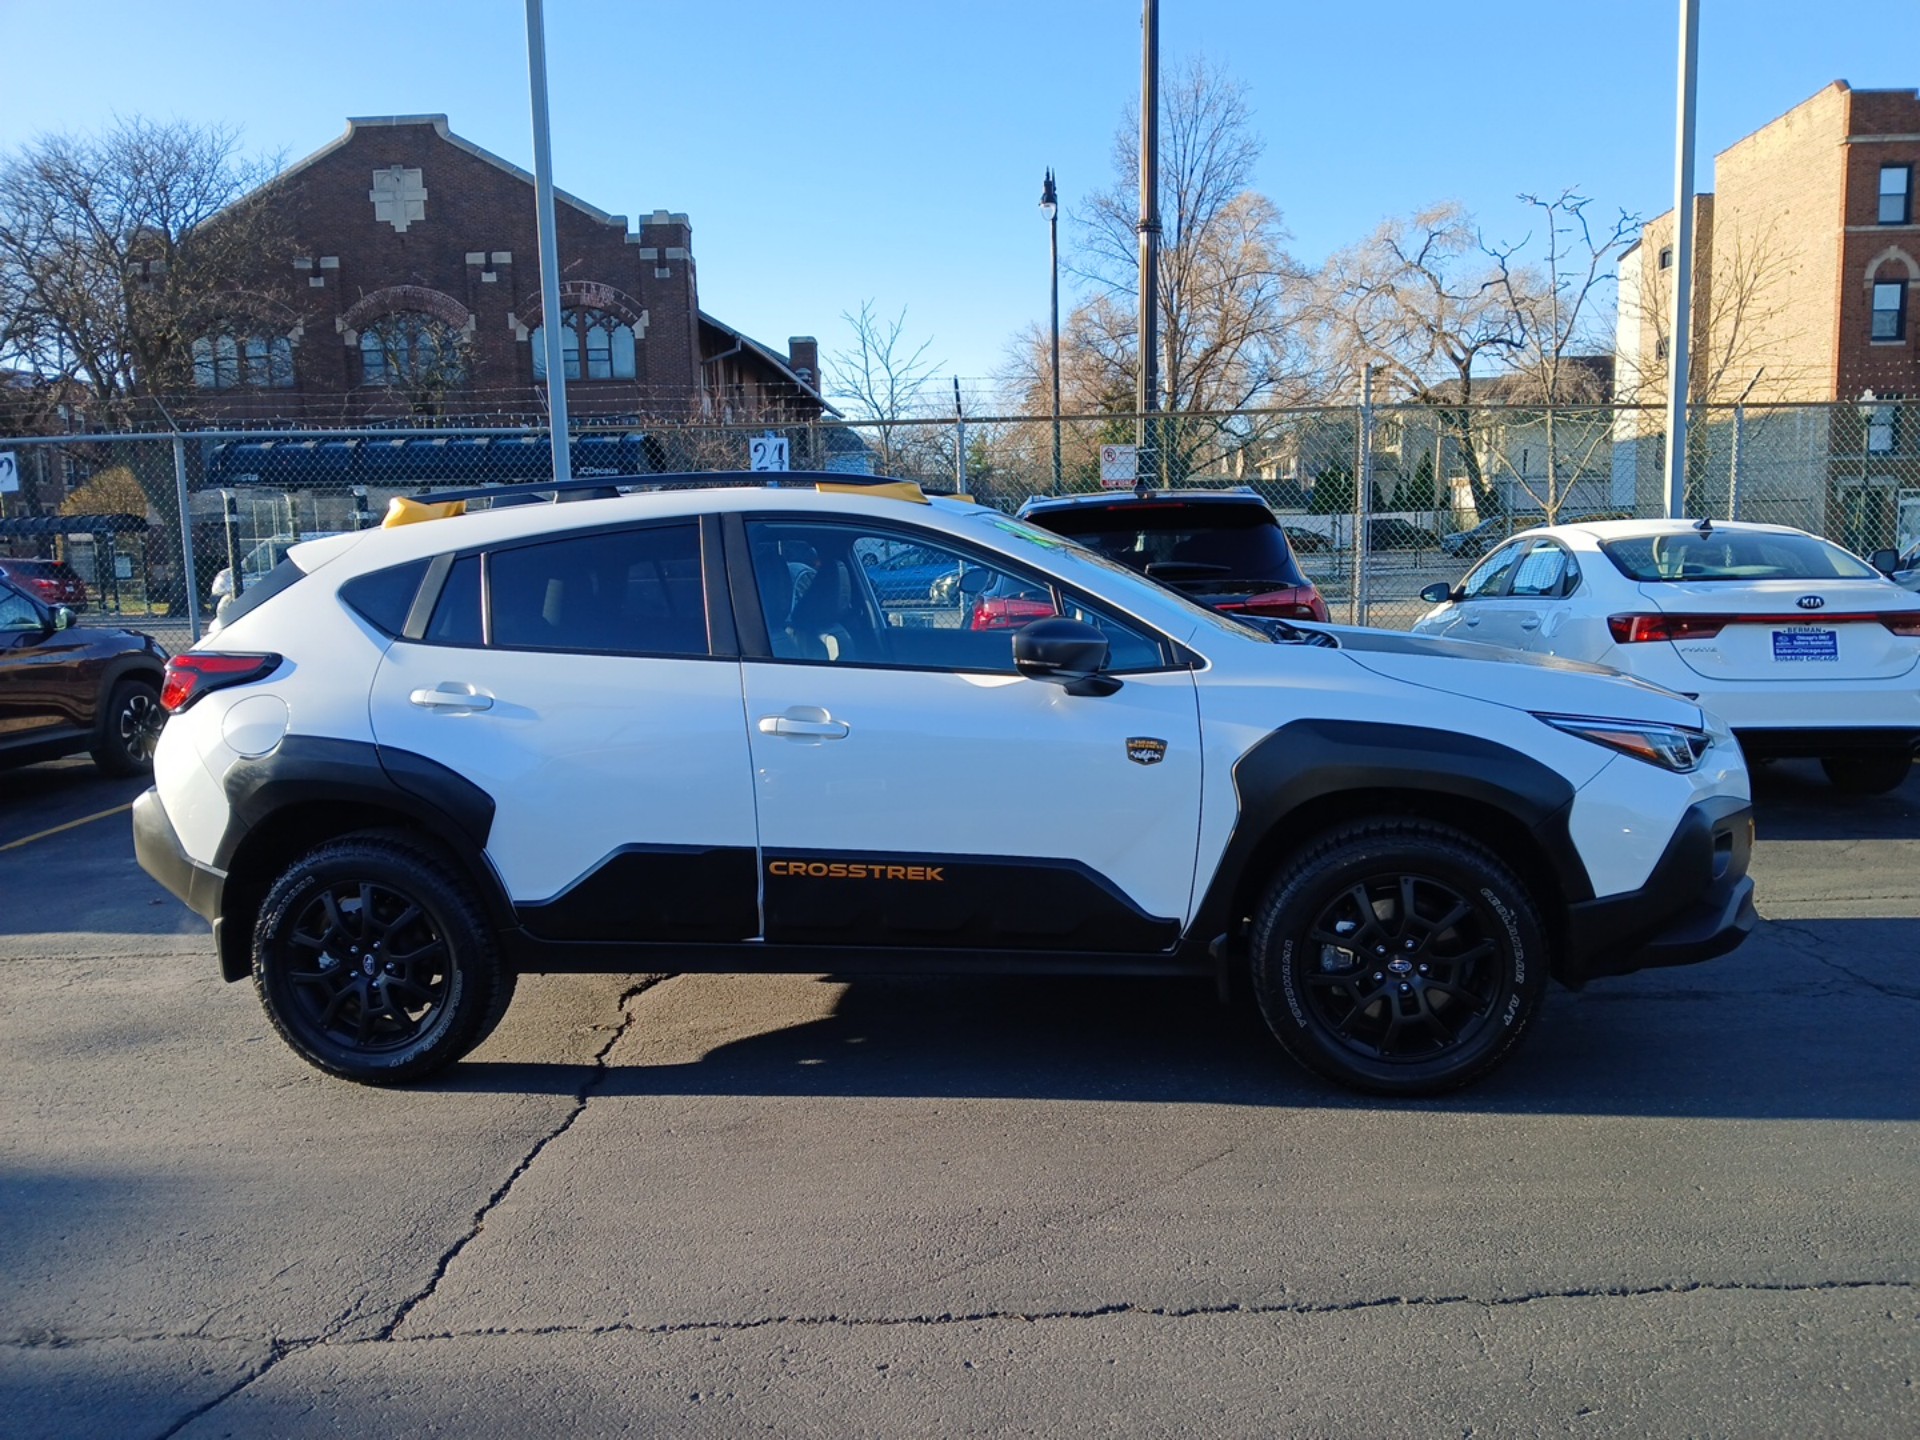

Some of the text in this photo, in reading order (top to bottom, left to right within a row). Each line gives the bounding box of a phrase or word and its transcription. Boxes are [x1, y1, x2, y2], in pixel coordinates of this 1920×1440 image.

[754, 442, 785, 471] 24
[1801, 598, 1822, 607] KIA
[768, 860, 945, 882] CROSSTREK
[1480, 887, 1525, 1027] GEOLANDAR A/T
[1282, 939, 1308, 1028] YOKOHAMA
